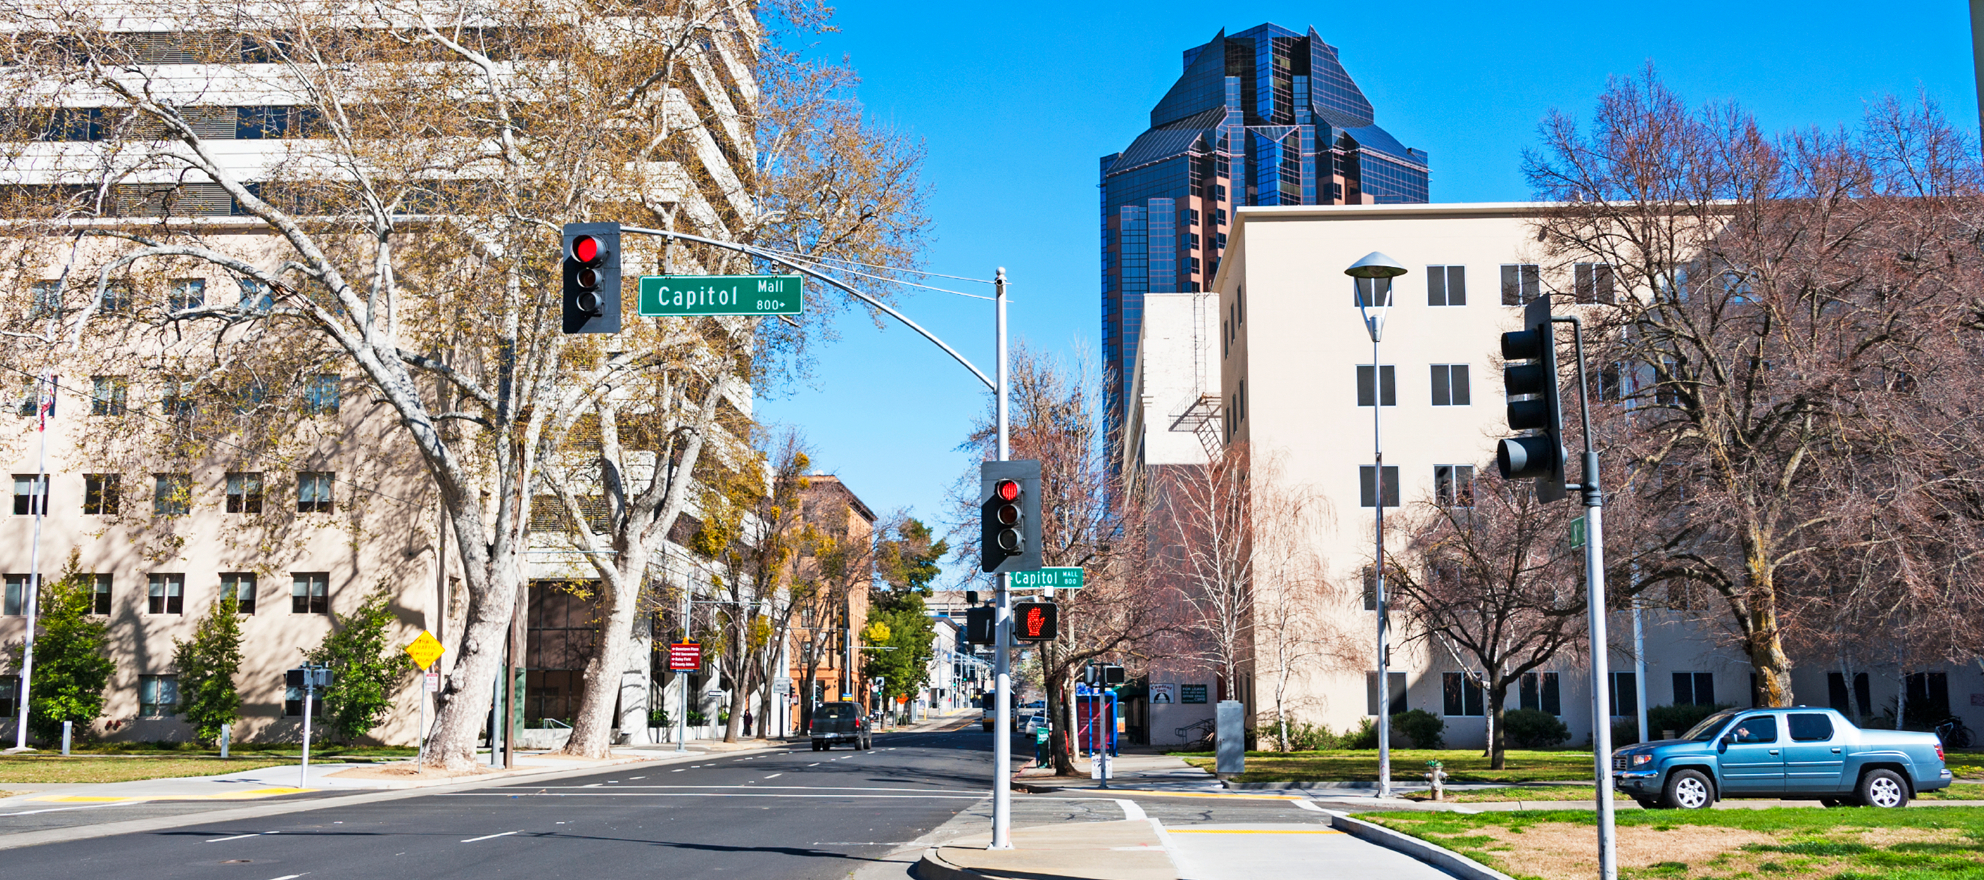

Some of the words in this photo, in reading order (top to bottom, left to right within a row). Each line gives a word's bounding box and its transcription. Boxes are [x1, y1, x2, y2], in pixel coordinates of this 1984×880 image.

[758, 280, 783, 292] Mall
[658, 286, 737, 310] Capitol
[1015, 571, 1057, 587] Capitol
